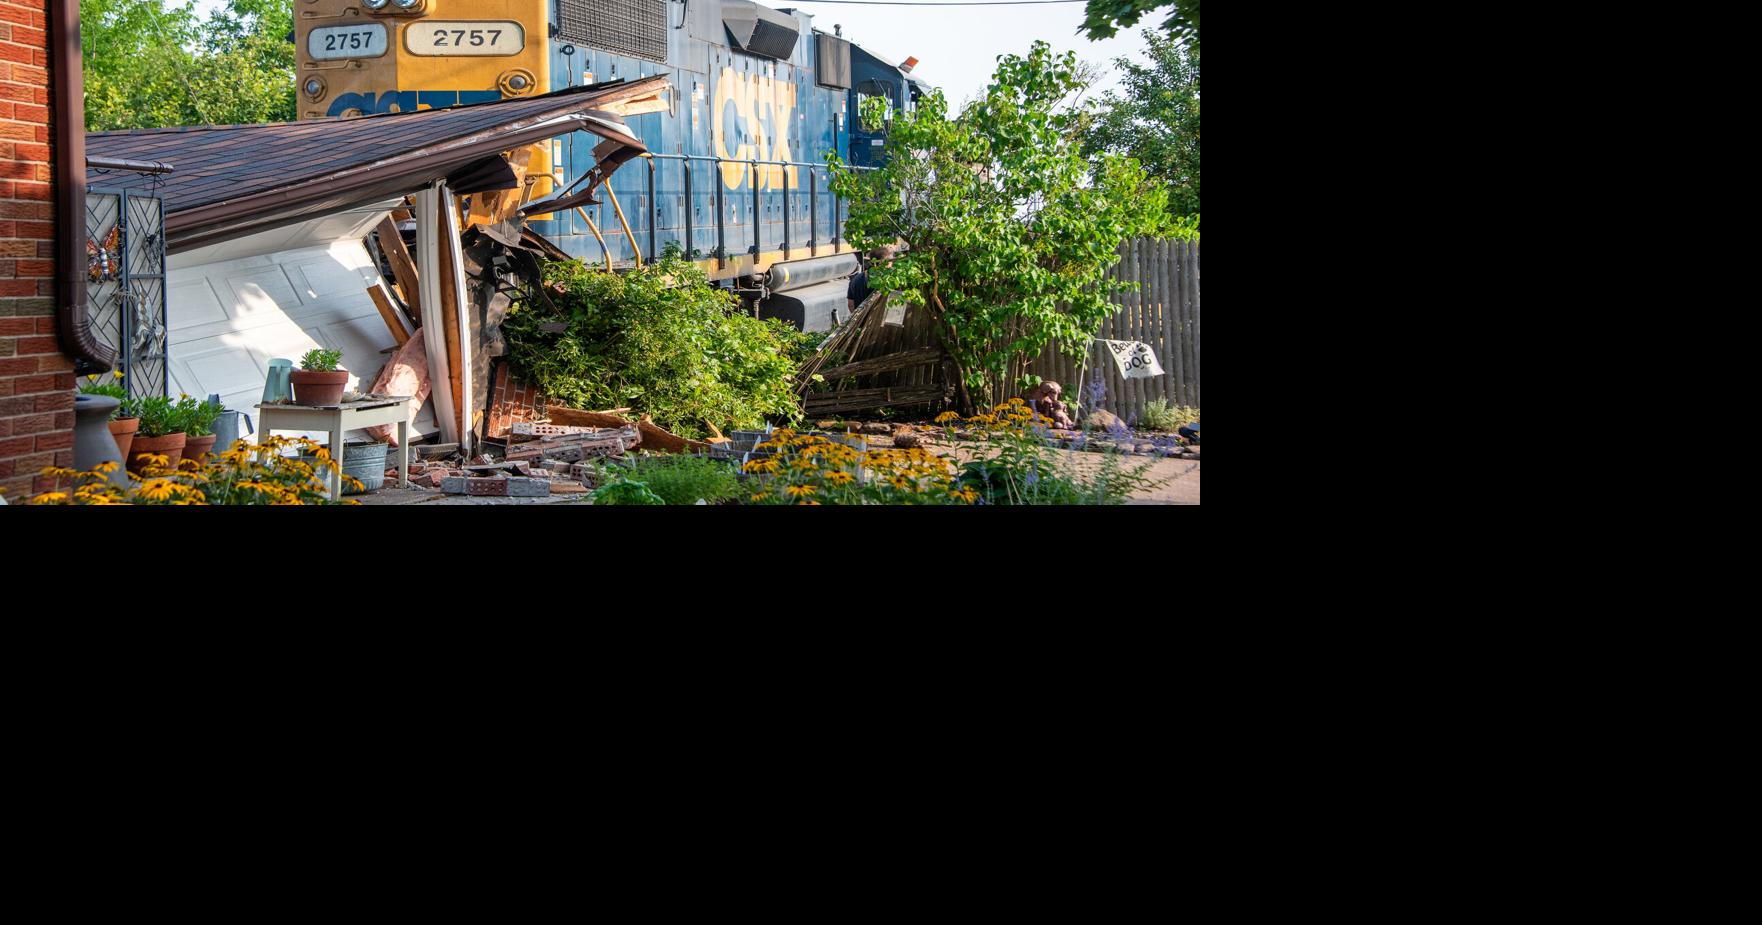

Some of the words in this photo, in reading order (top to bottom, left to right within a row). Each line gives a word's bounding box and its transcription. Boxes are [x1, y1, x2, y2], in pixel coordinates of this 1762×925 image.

[325, 31, 373, 51] 2757
[433, 29, 503, 47] 2757
[714, 67, 798, 190] CSX
[1124, 354, 1152, 371] DOG
